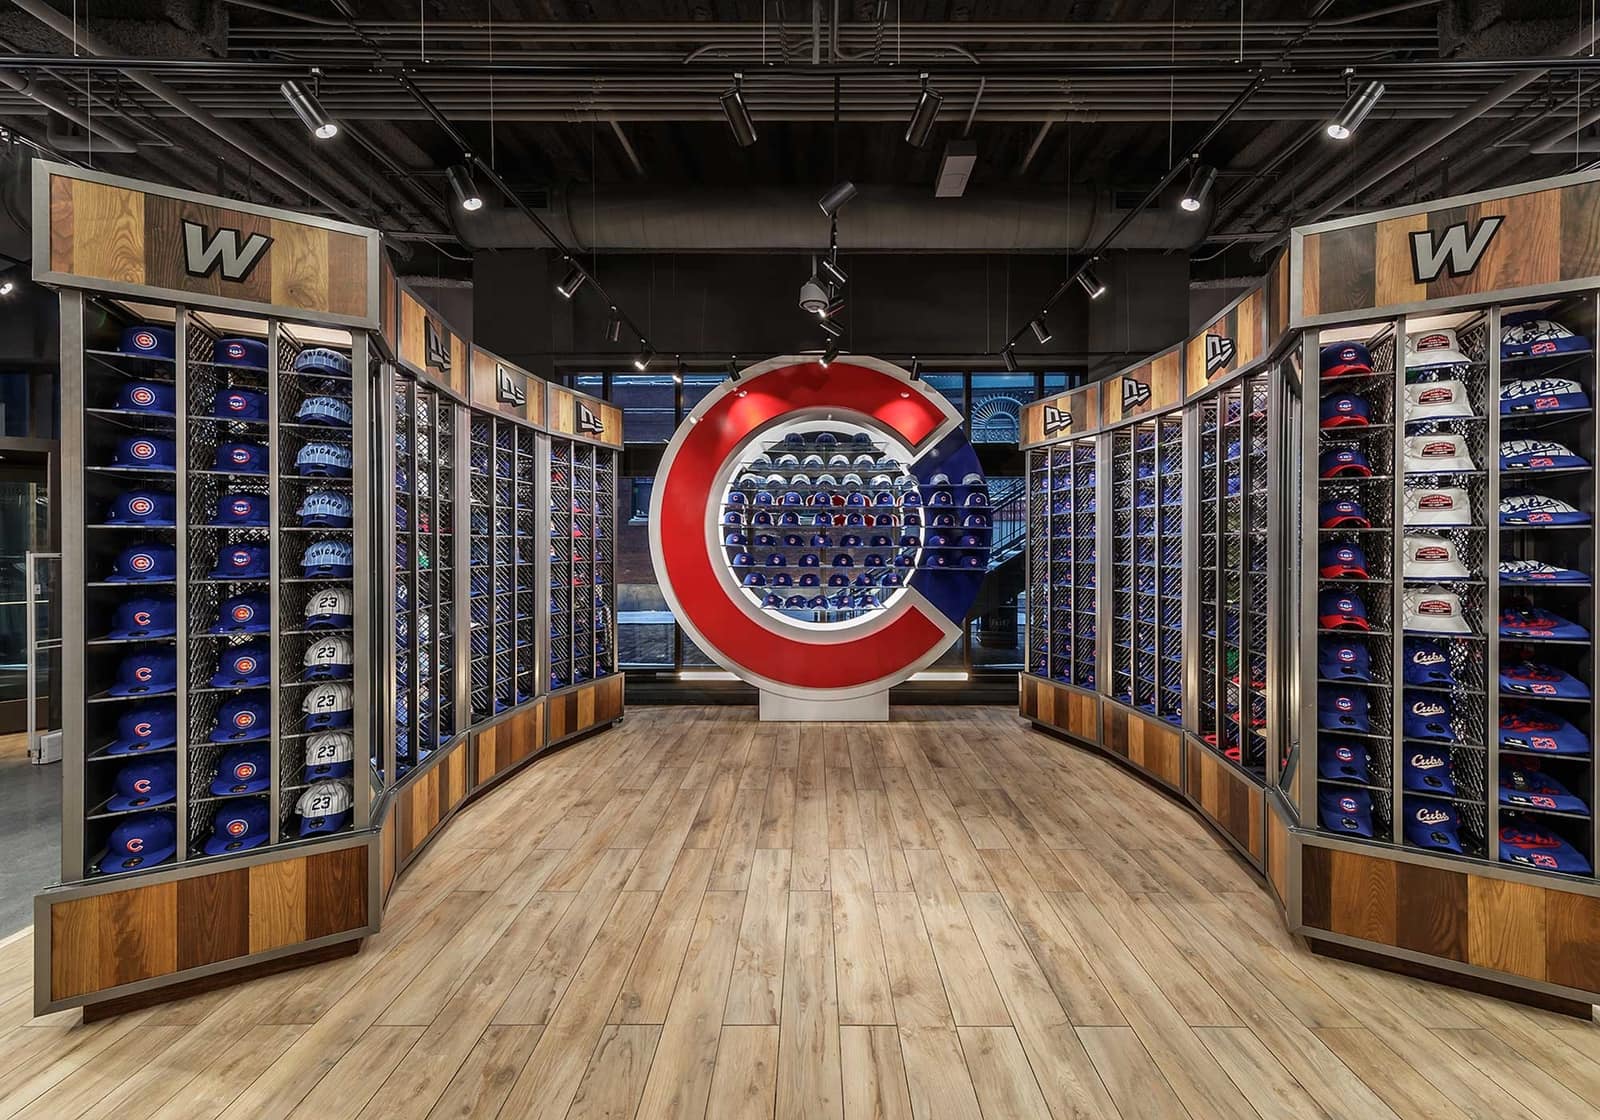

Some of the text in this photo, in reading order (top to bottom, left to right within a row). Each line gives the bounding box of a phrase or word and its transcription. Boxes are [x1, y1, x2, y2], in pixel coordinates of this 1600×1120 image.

[181, 219, 274, 282] W
[1409, 216, 1505, 284] W
[305, 400, 341, 413] CHICAGO
[305, 447, 341, 460] CHICAGO
[307, 498, 343, 510] CHICAGO
[311, 548, 347, 559] CHICAGO
[319, 597, 338, 608] 23
[134, 611, 151, 626] C
[317, 647, 336, 659] 23
[1413, 651, 1446, 666] Cubs
[135, 667, 152, 681] C
[317, 695, 336, 707] 23
[1412, 701, 1445, 716] Cubs
[134, 723, 152, 737] C
[317, 745, 336, 759] 23
[1411, 754, 1444, 770] Cubs
[134, 779, 151, 793] C
[311, 796, 331, 810] 23
[1416, 808, 1449, 825] Cubs
[126, 838, 144, 853] C
